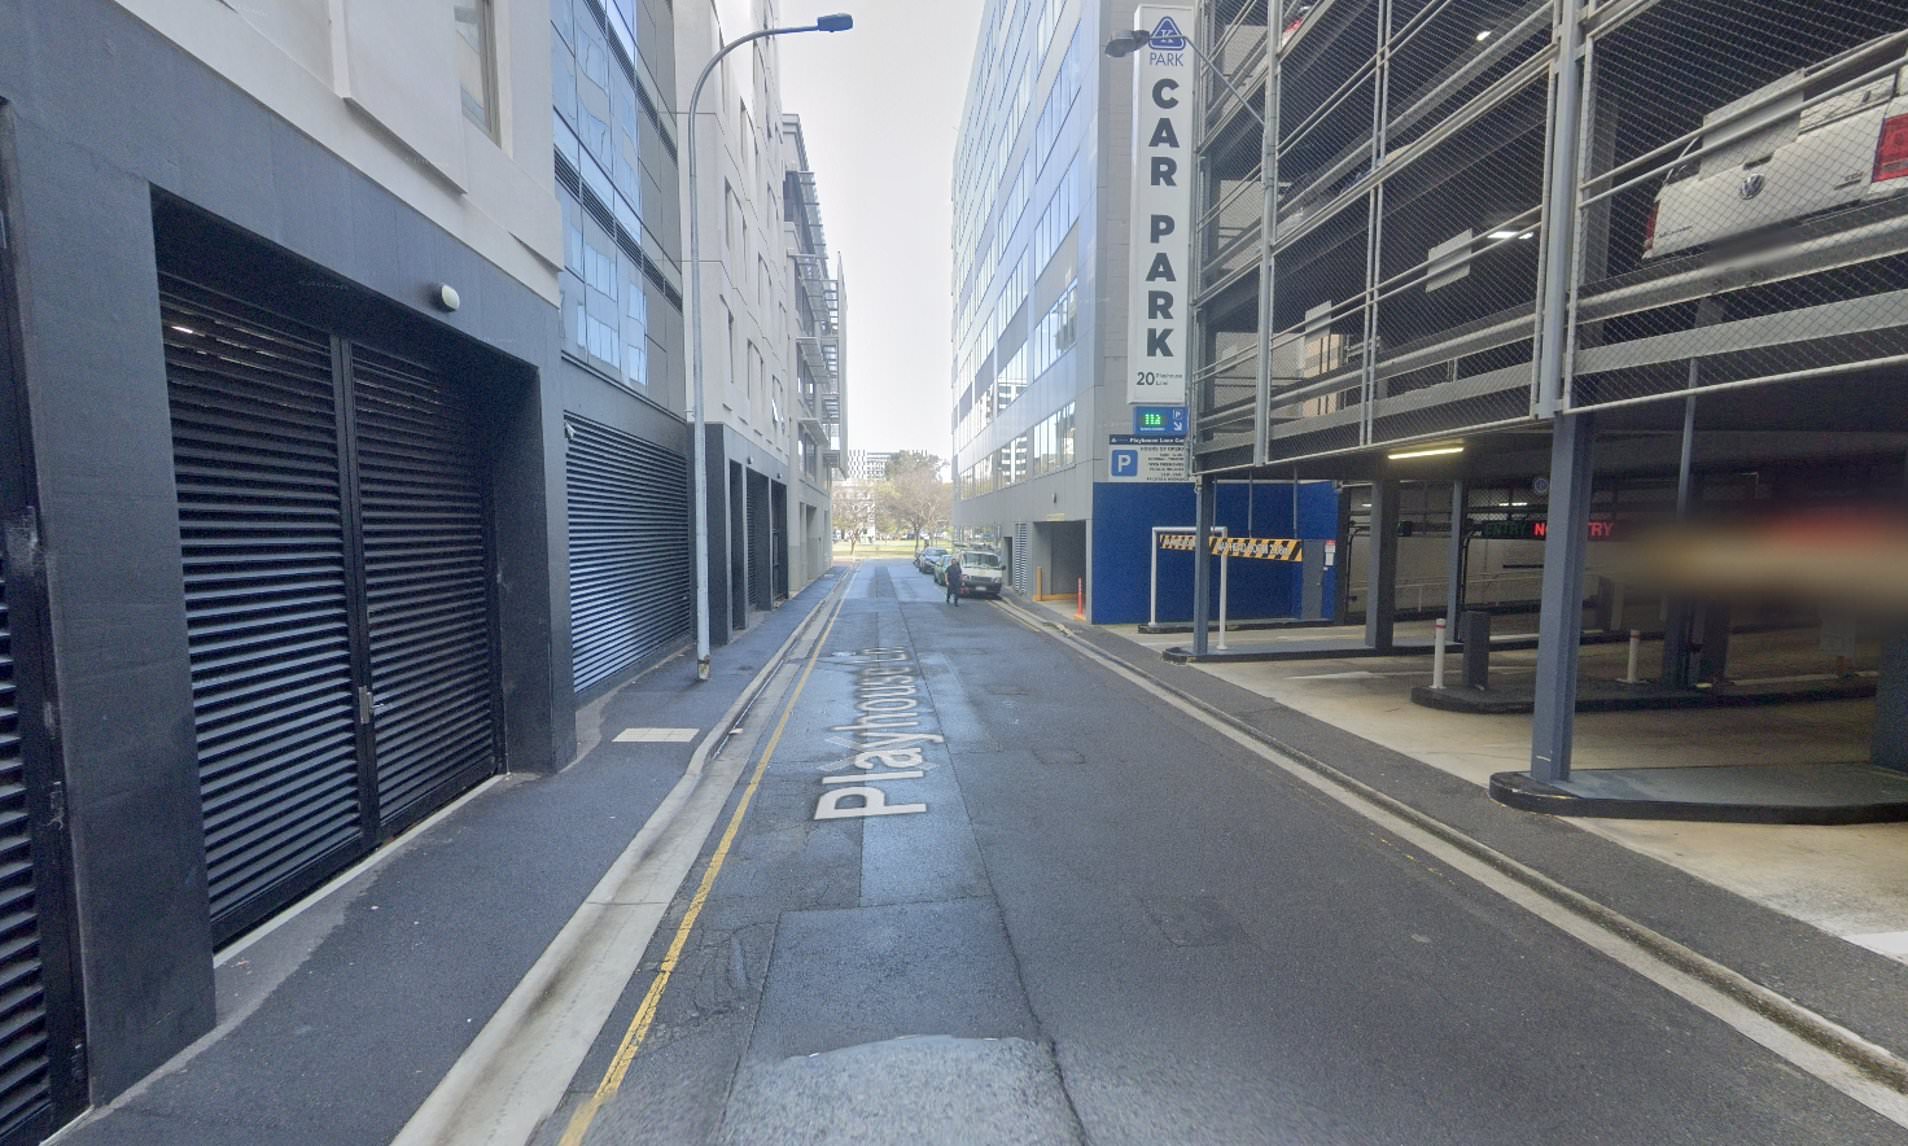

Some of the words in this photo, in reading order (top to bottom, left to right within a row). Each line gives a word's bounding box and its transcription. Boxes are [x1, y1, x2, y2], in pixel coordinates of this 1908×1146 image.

[1149, 52, 1184, 67] PARK
[1148, 78, 1180, 187] CAR
[1145, 214, 1177, 357] PARK
[1136, 371, 1155, 386] 20
[1118, 454, 1131, 472] P
